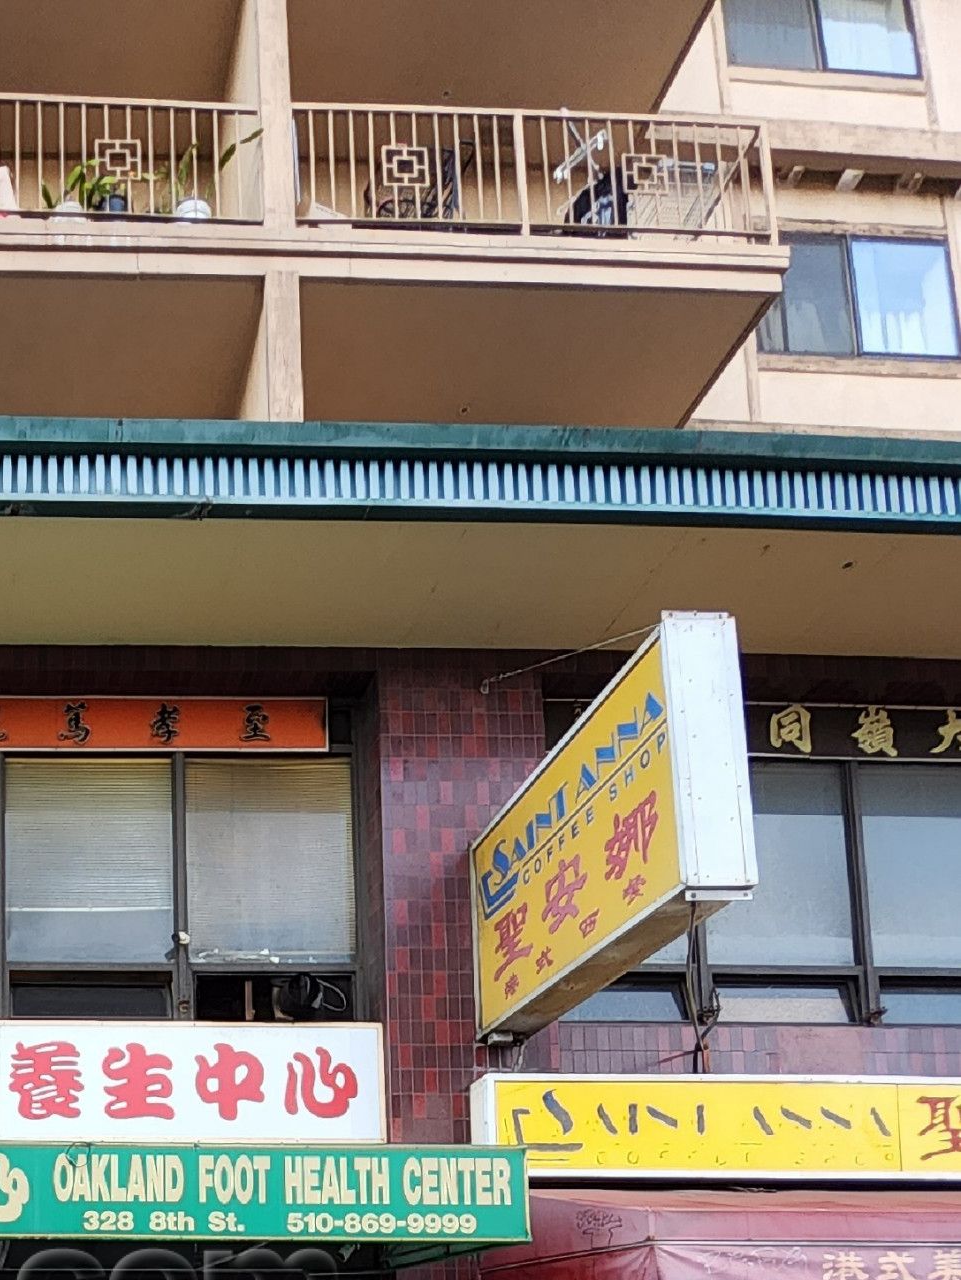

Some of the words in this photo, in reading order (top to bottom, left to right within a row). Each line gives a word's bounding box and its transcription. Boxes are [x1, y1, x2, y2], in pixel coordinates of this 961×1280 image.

[576, 692, 664, 803] ANNA
[522, 805, 594, 885] COFFEE
[608, 731, 666, 802] SHOP
[53, 1153, 184, 1202] OAKLAND
[199, 1154, 271, 1204] FOOT
[284, 1155, 390, 1205] HEALTH
[403, 1156, 513, 1207] CENTER
[83, 1211, 134, 1232] 328
[149, 1211, 195, 1232] 8th
[208, 1212, 245, 1233] St.
[287, 1213, 477, 1235] 510-869-9999
